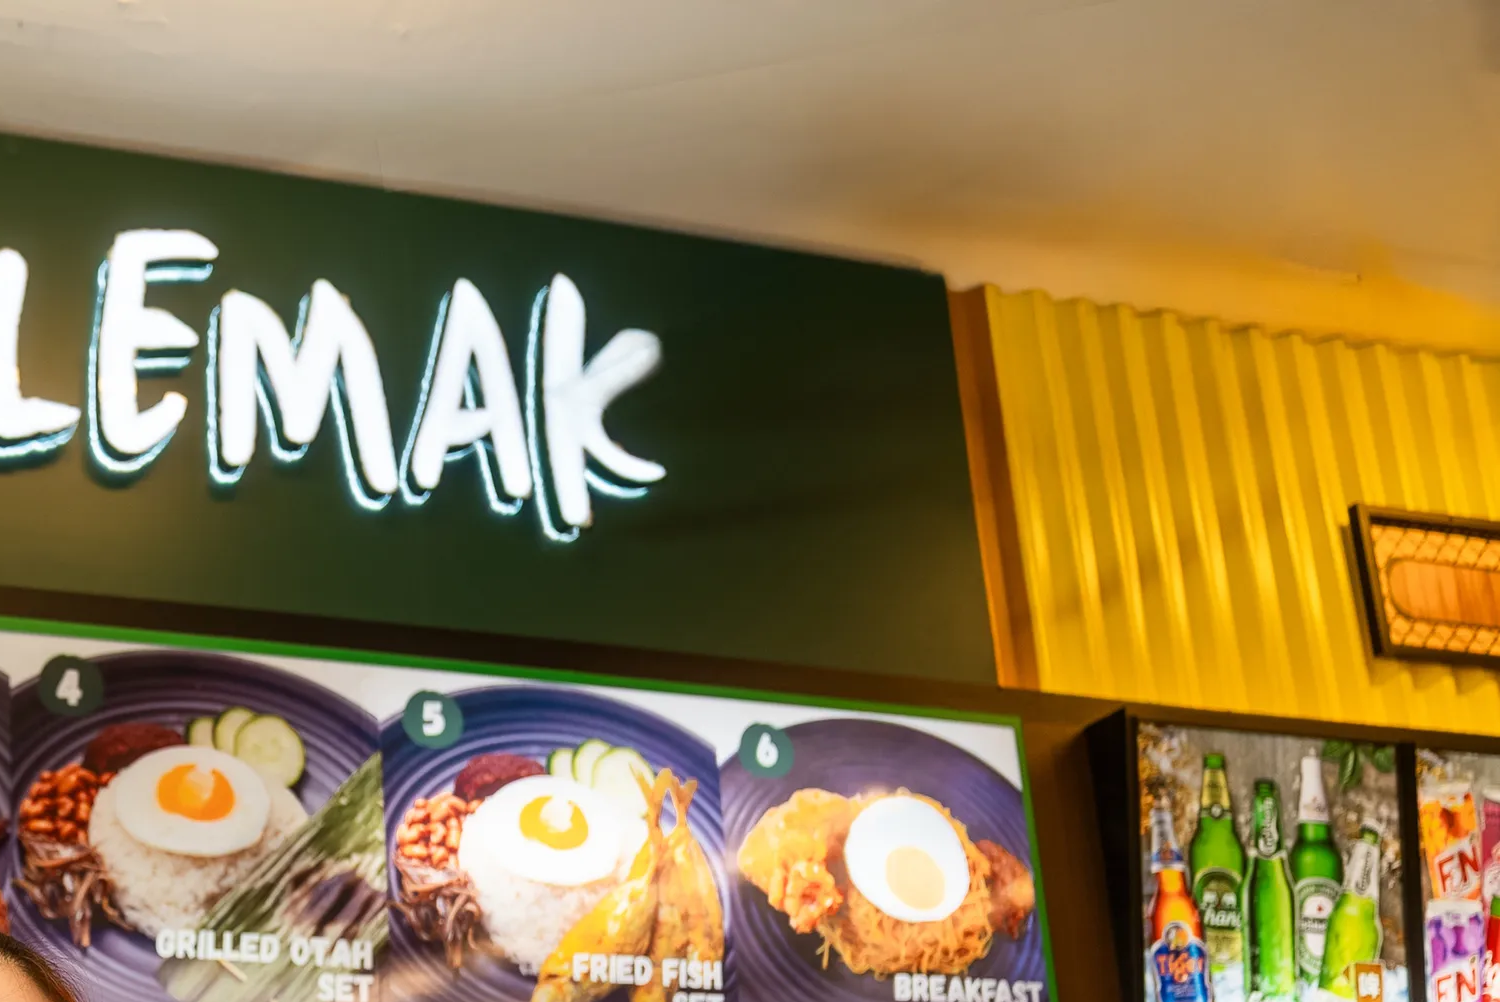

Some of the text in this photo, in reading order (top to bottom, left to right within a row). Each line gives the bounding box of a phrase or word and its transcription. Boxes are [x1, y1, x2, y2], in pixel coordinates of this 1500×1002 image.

[54, 668, 83, 707] 4
[421, 700, 446, 737] 5
[755, 736, 779, 768] 6
[155, 928, 374, 970] GRILLED OTAH
[571, 952, 724, 990] FRIED FISH
